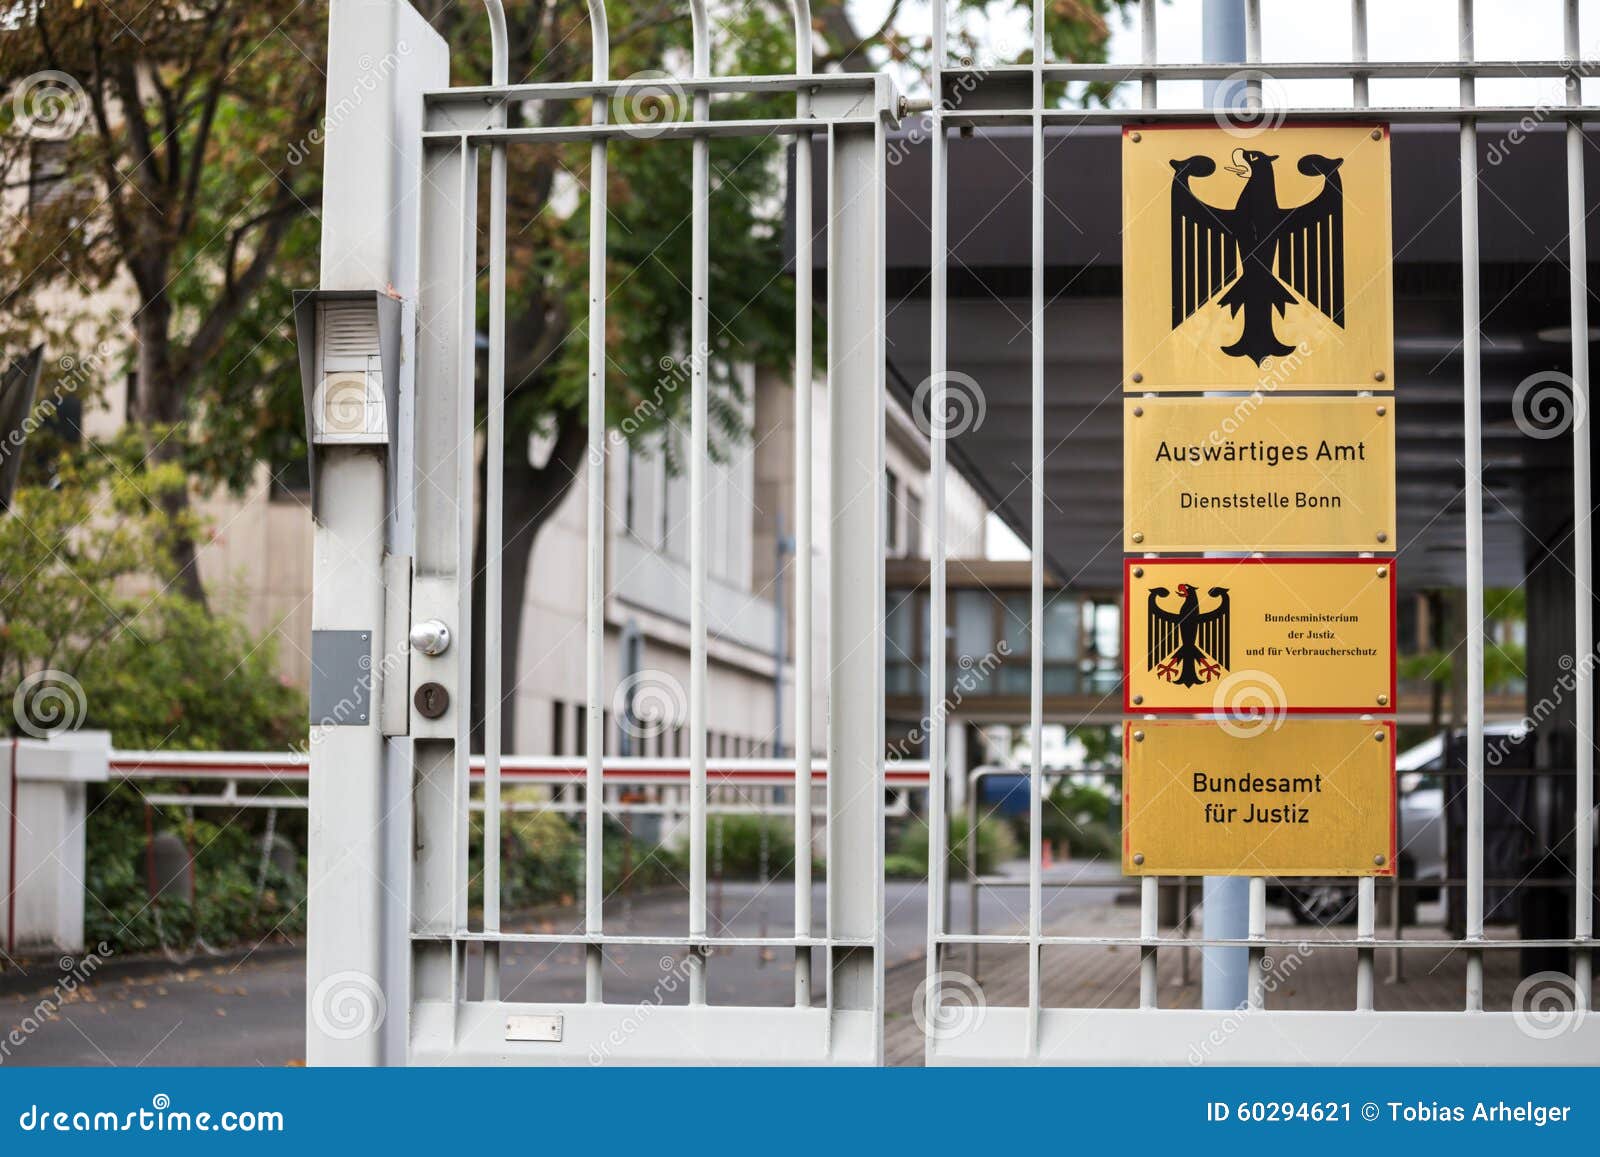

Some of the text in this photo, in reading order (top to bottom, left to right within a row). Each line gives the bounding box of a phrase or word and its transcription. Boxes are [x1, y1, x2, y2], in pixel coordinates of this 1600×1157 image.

[1155, 440, 1365, 467] Auswärtiges Amt
[1180, 491, 1342, 509] Dienststelle Bonn
[1264, 613, 1359, 623] Bundesministerium
[1287, 630, 1335, 639] der Justiz
[1246, 647, 1377, 656] und für Verbraucherschutz
[1193, 772, 1322, 793] Bundesamt
[1204, 803, 1309, 824] für Justiz
